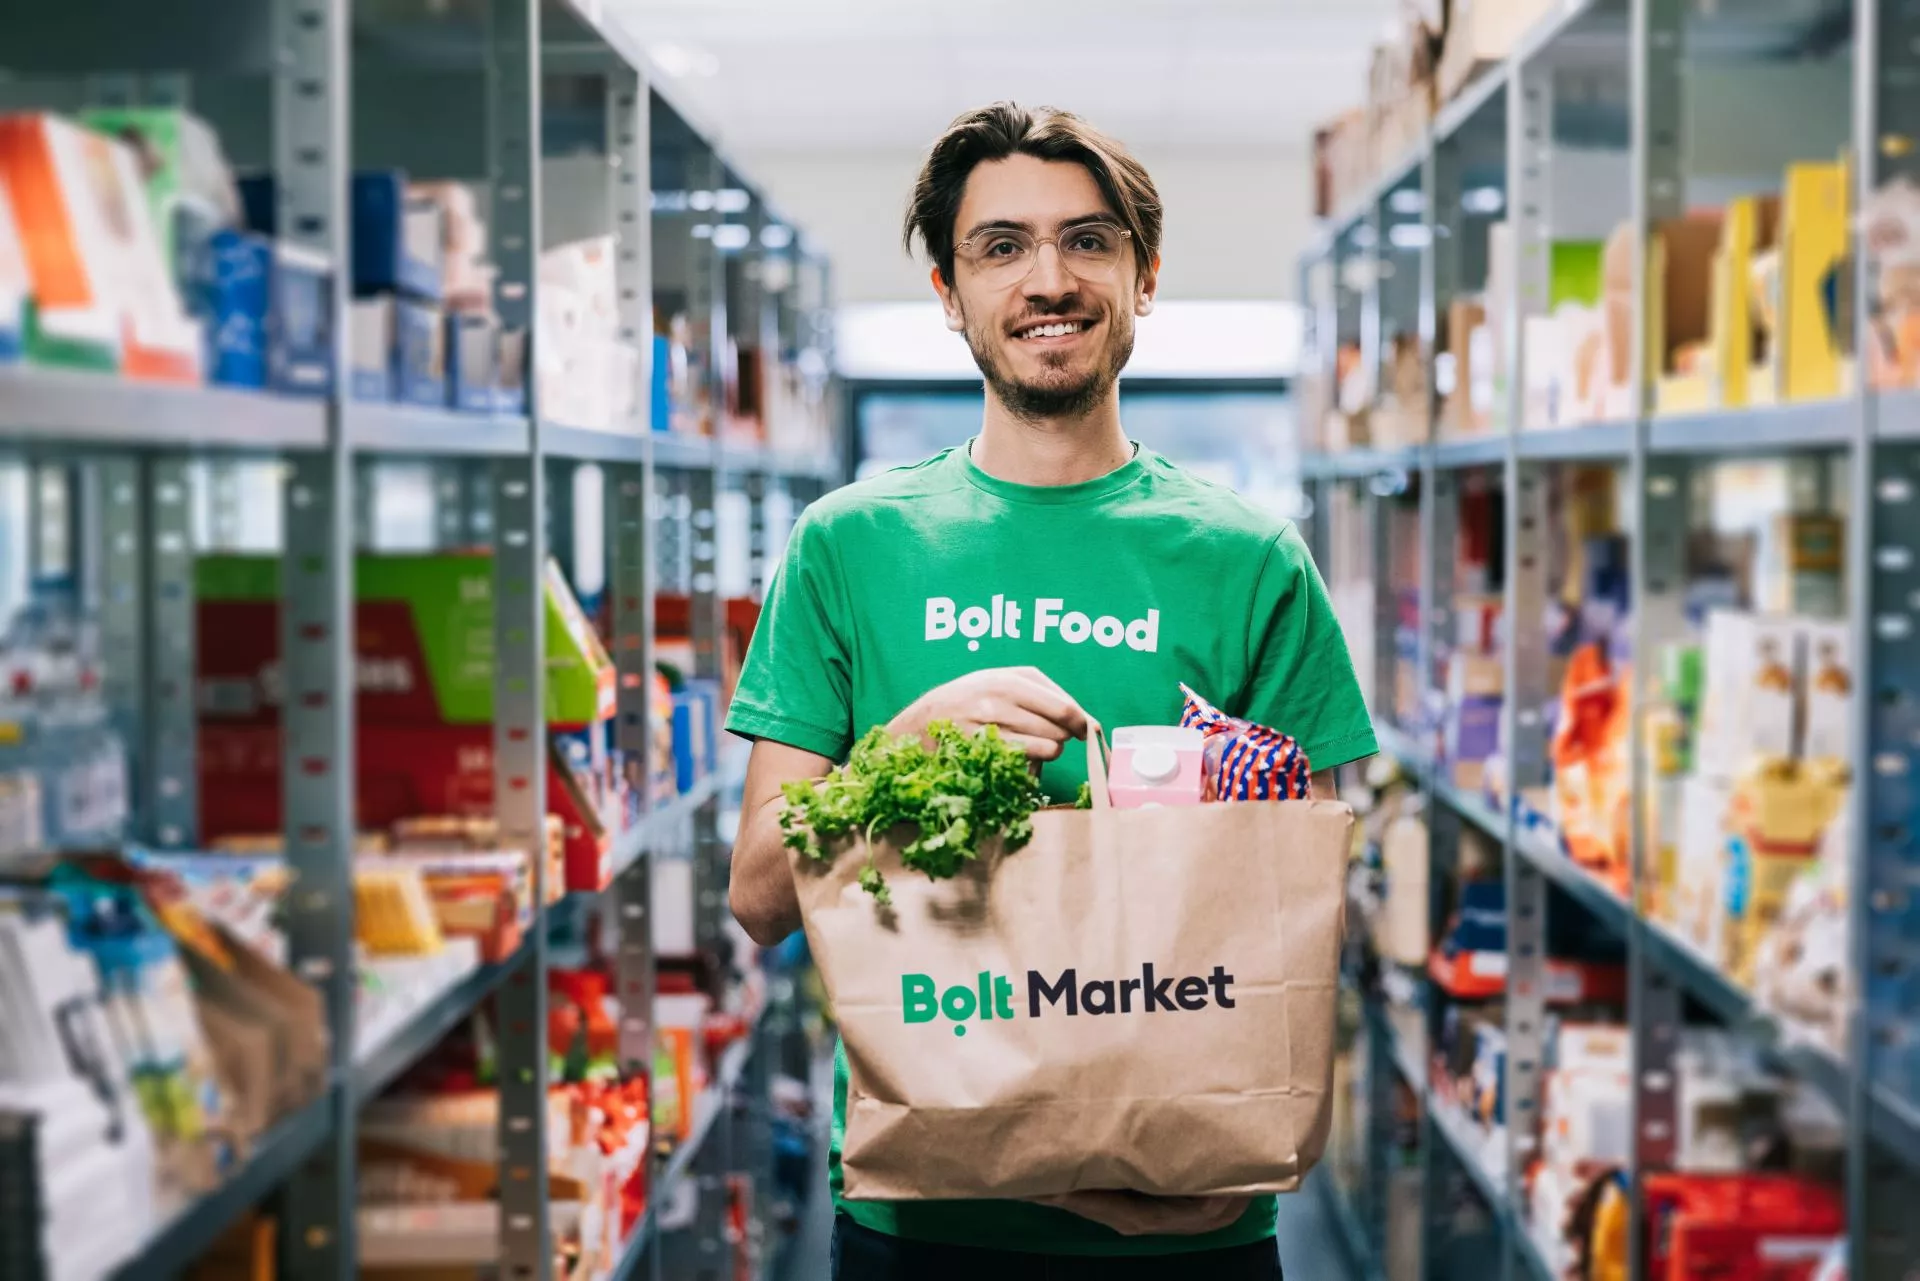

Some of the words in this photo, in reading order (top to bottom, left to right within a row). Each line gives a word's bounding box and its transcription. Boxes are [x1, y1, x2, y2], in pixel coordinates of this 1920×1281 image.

[925, 594, 1022, 652] Bolt
[1033, 598, 1160, 653] Food
[901, 971, 1015, 1037] Bolt
[1027, 962, 1236, 1018] Market
